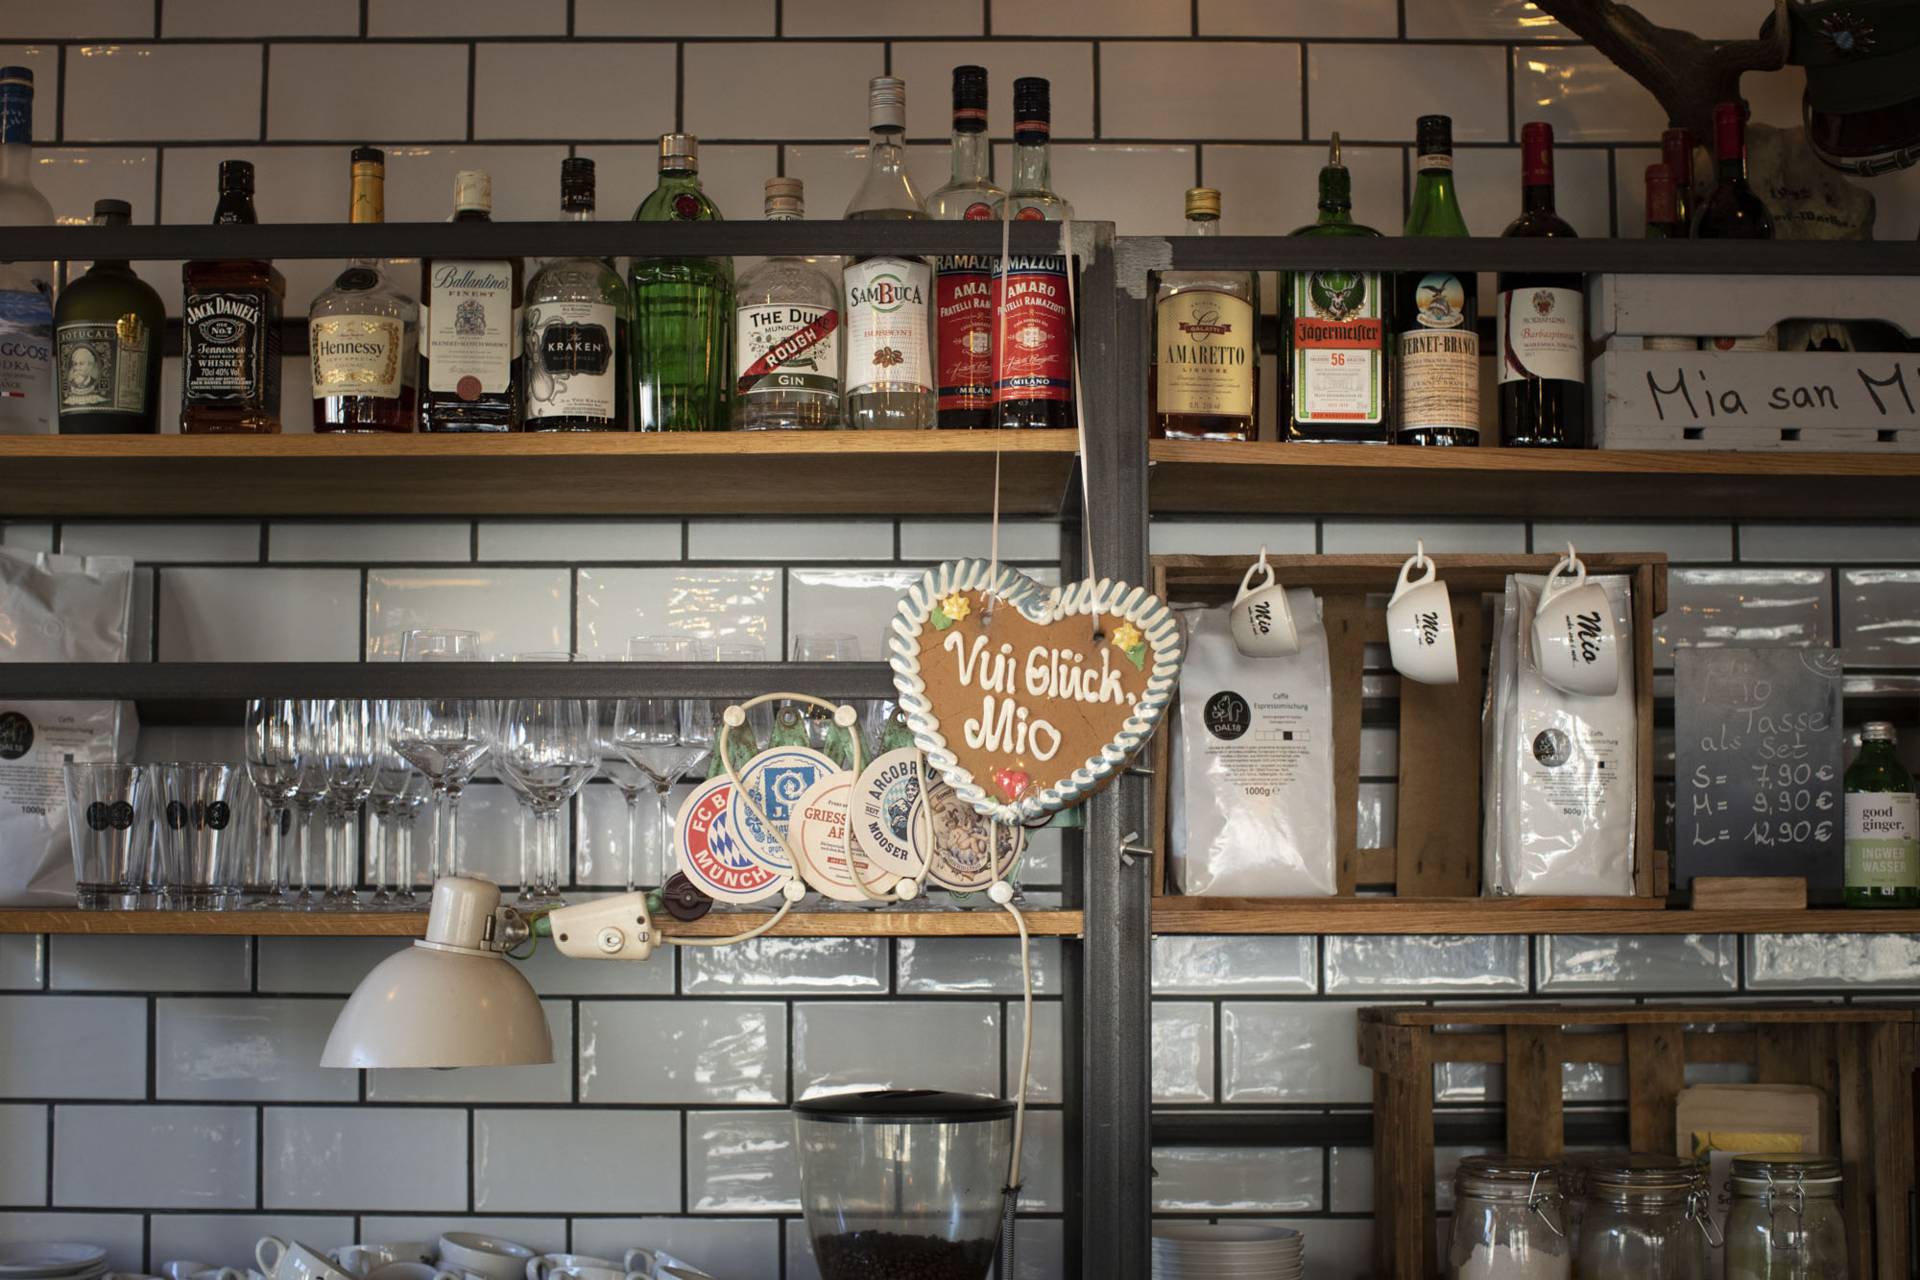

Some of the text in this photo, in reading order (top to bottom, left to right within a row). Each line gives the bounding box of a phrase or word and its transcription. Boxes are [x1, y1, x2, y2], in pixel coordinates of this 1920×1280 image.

[851, 283, 922, 307] SAMBUCA
[954, 282, 992, 299] AMA
[1008, 280, 1056, 298] AMARO
[187, 296, 260, 325] JACK DANIEL'S
[940, 299, 972, 318] FRATELLI
[750, 311, 783, 328] THE
[765, 324, 799, 333] MUNICH
[320, 340, 385, 358] Hennessy
[548, 342, 601, 352] KRAKEN
[765, 328, 817, 367] ROUGH
[1165, 344, 1244, 365] AMARETTO
[0, 361, 30, 371] DKA
[198, 359, 246, 368] WHISKEY
[1331, 352, 1345, 366] 56
[778, 375, 805, 386] GIN
[960, 386, 992, 394] MILAN
[1646, 363, 1920, 421] Mia san M
[1254, 601, 1272, 636] Mio
[1422, 611, 1439, 647] Mio
[1577, 611, 1602, 664] Mio
[944, 631, 1137, 706] Vui Glück,
[964, 695, 1061, 761] Mio
[1736, 703, 1830, 735] Tasse
[1700, 723, 1808, 759] als Set
[869, 761, 938, 801] ARCOBRU
[1245, 787, 1271, 796] 1000g
[22, 806, 46, 815] 1000g
[865, 806, 880, 816] SEIT
[1563, 808, 1582, 816] 500g
[1863, 806, 1893, 821] good
[692, 807, 713, 833] FC
[1863, 819, 1905, 833] ginger.
[869, 821, 909, 862] MOOSER
[1862, 861, 1907, 873] WASSER
